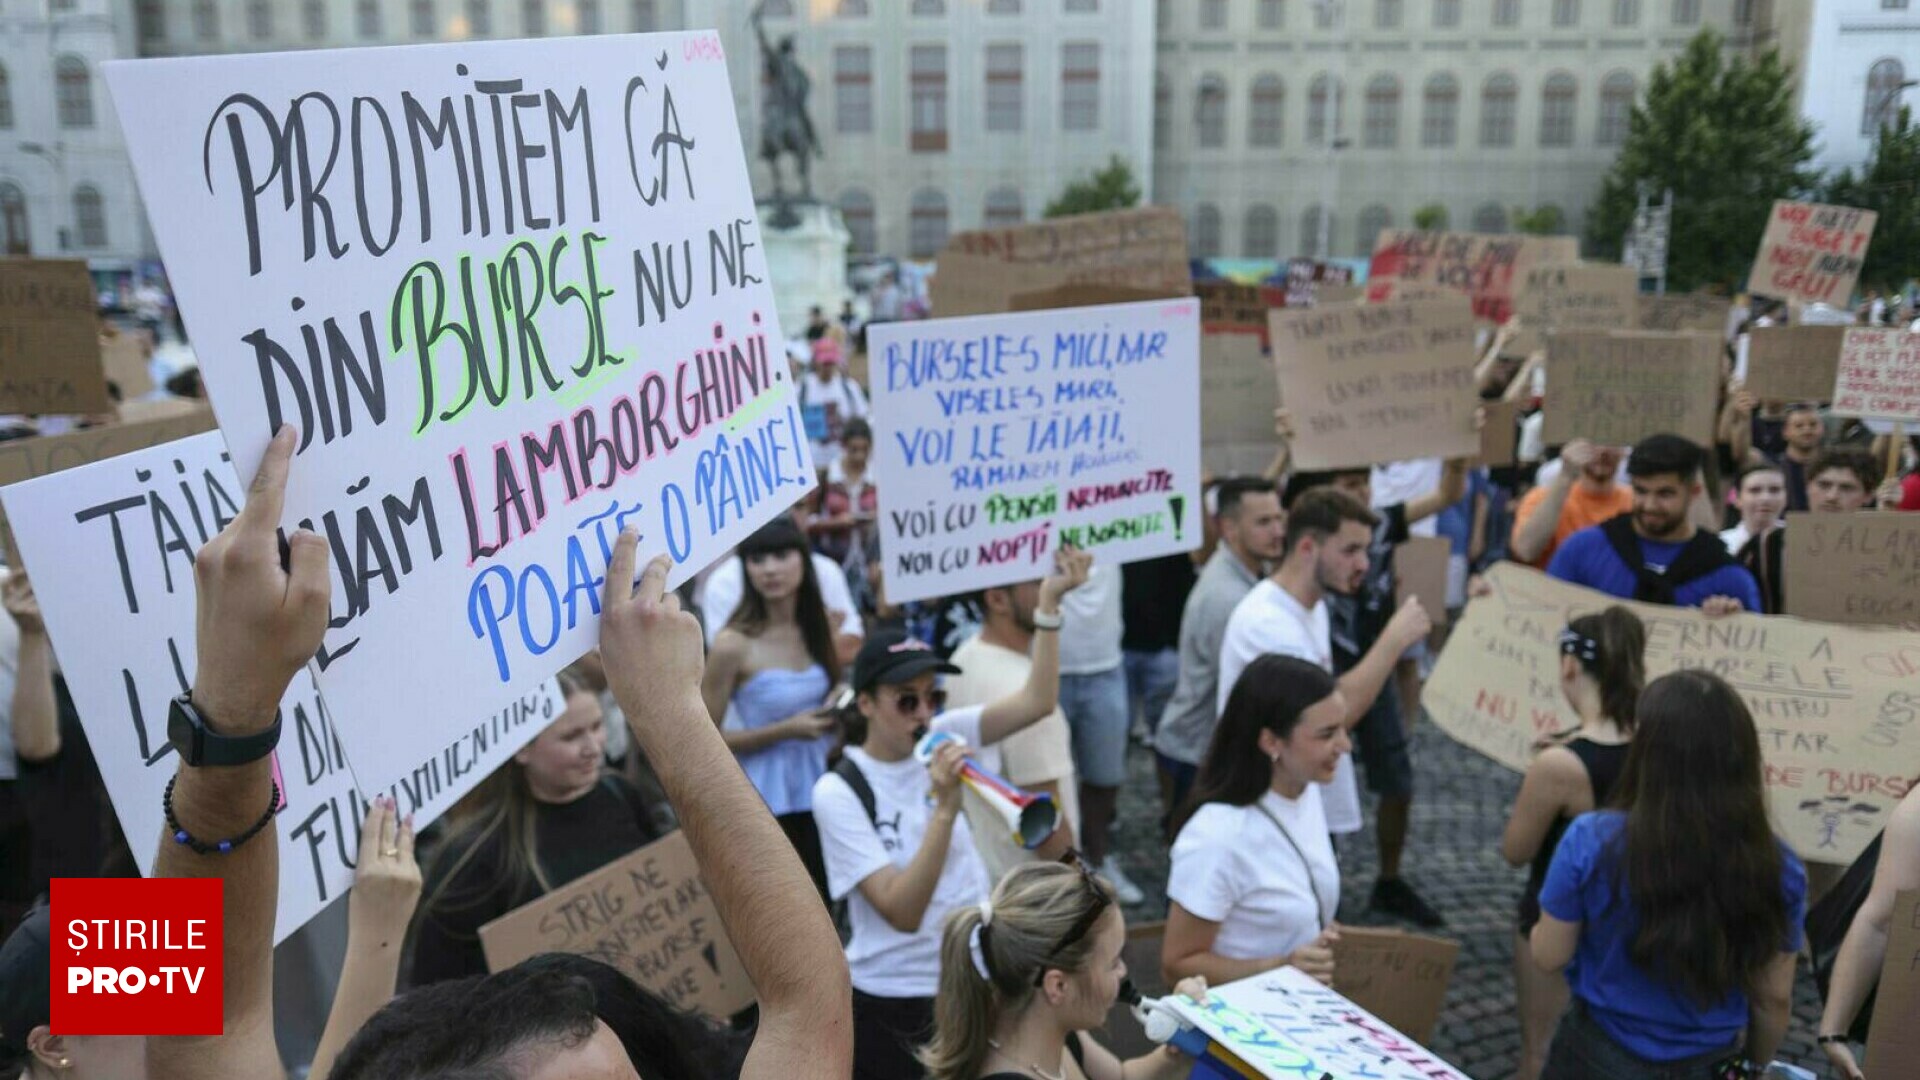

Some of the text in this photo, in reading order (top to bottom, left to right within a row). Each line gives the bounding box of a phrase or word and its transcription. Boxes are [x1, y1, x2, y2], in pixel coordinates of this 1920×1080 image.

[203, 49, 695, 276] PROMITEM CĂ
[241, 219, 763, 455] DIN BURSE NU NE
[970, 422, 1010, 462] LE
[661, 482, 692, 565] O
[892, 500, 936, 538] VOI
[943, 502, 977, 533] CU
[897, 550, 934, 578] NOI
[938, 547, 970, 574] CU
[1767, 728, 1840, 754] TAR
